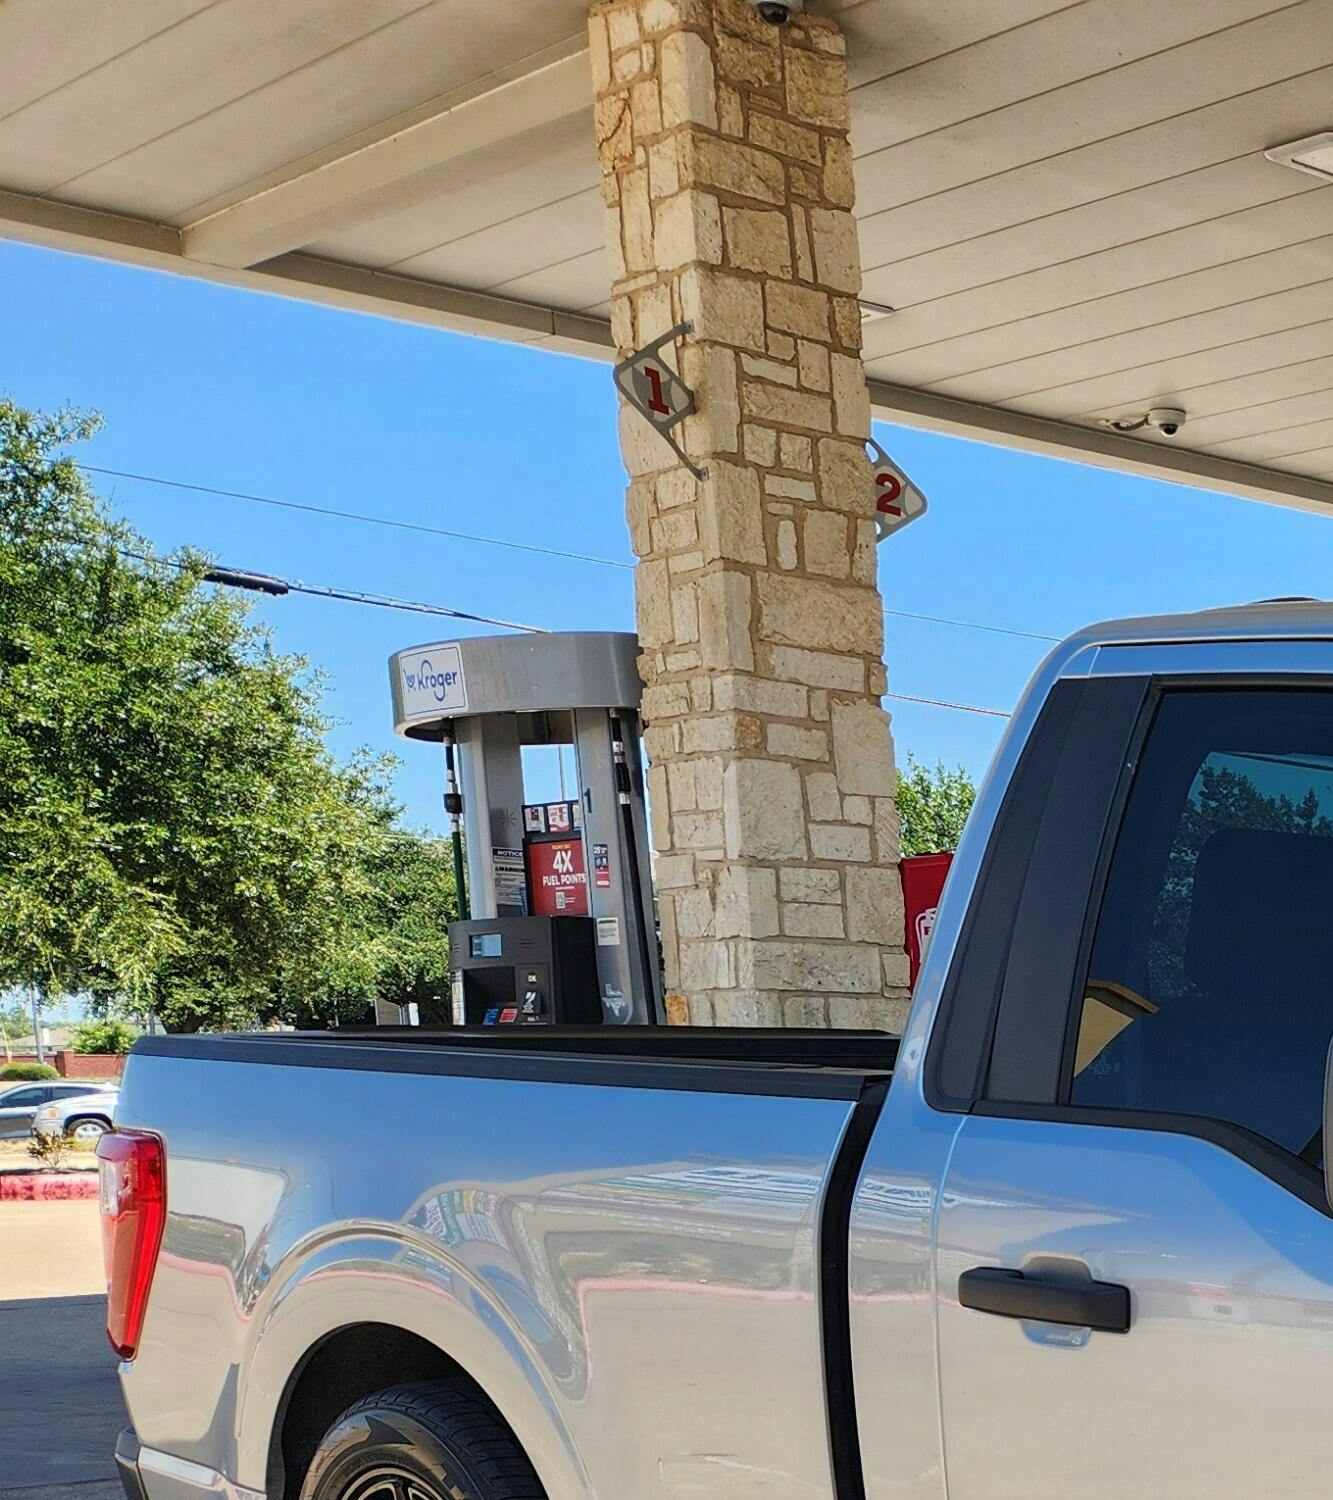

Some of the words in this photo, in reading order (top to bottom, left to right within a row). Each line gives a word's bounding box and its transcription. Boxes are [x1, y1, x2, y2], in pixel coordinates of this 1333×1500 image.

[644, 366, 669, 415] 1
[875, 473, 901, 517] 2
[417, 660, 457, 702] Kroger
[583, 788, 593, 814] 1
[552, 850, 574, 873] 4X
[542, 875, 561, 887] FUEL
[561, 873, 587, 885] POINTS
